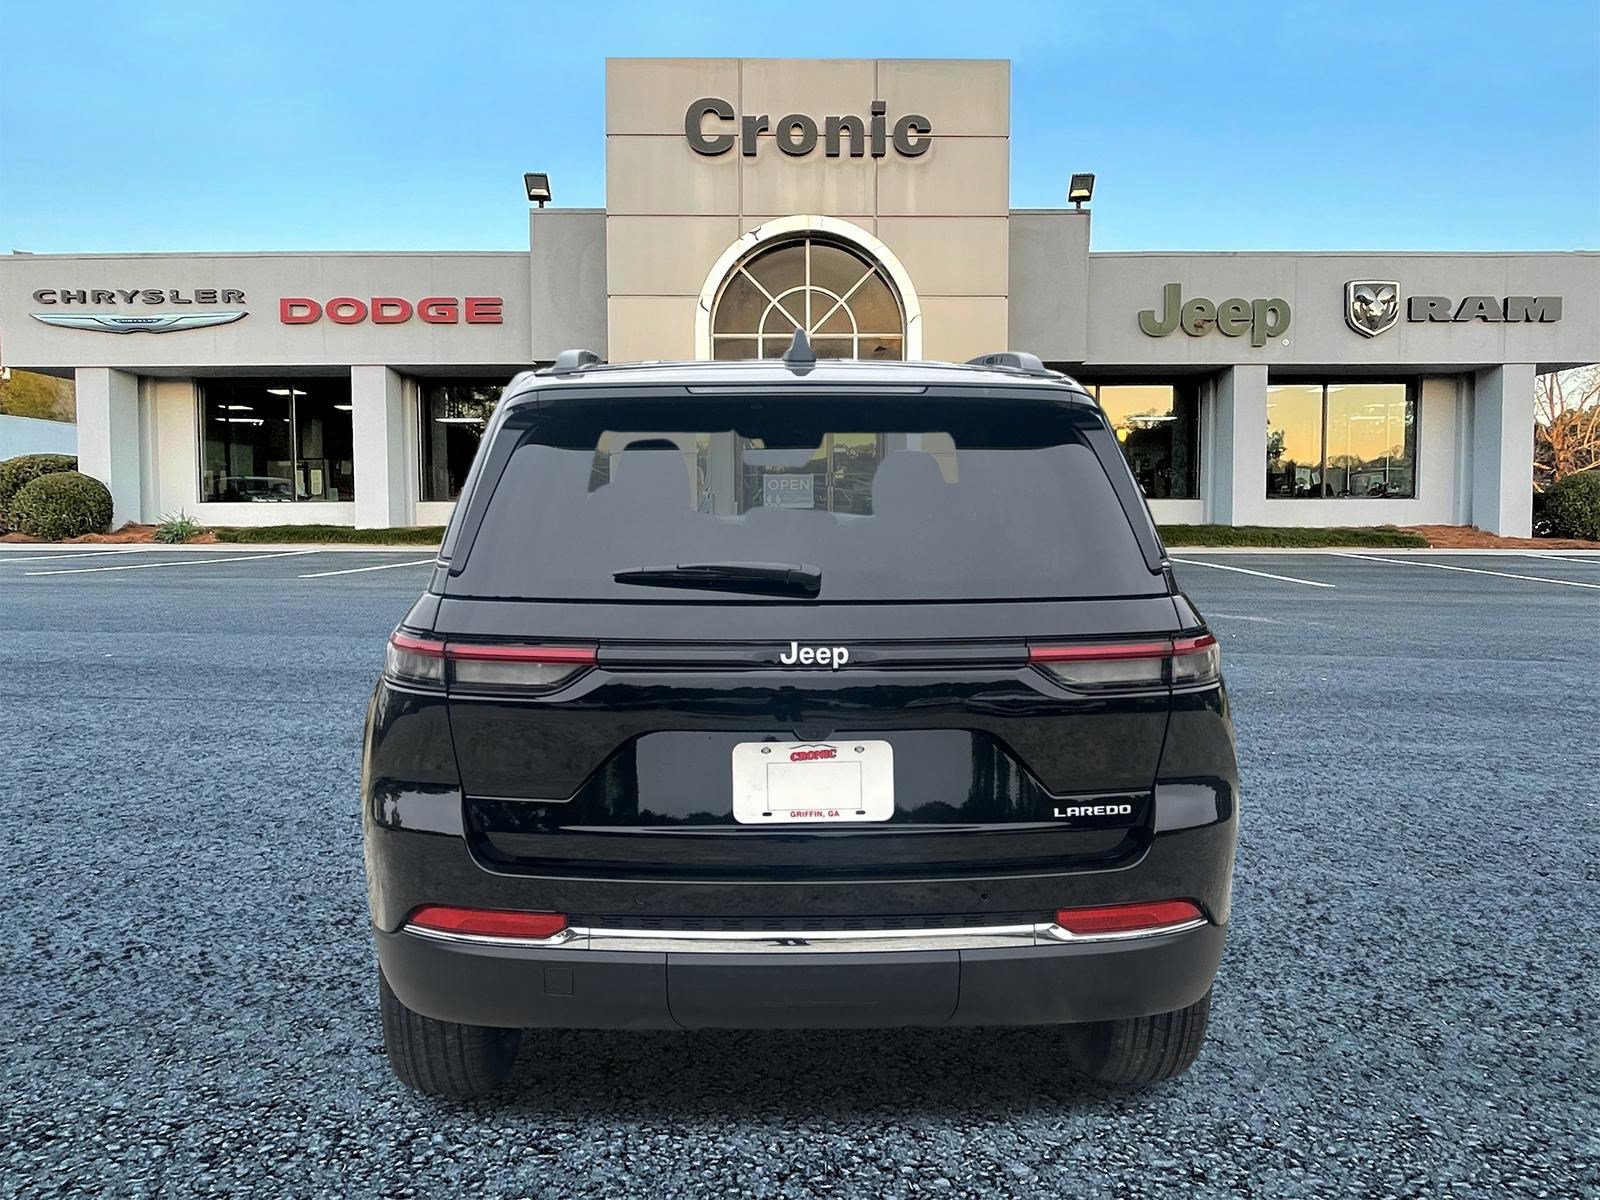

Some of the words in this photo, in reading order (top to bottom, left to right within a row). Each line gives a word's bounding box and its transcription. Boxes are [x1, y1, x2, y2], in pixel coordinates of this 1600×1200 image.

[685, 97, 932, 157] Cronic
[32, 288, 246, 304] CHRYSLER
[280, 297, 503, 324] DODGE
[1138, 283, 1291, 347] Jeep
[1407, 296, 1563, 322] RAM
[768, 479, 810, 490] OPEN
[780, 641, 849, 669] Jeep
[790, 749, 837, 761] CRONIC
[790, 810, 825, 818] GRIFFIN,
[1053, 804, 1132, 818] LAREDO
